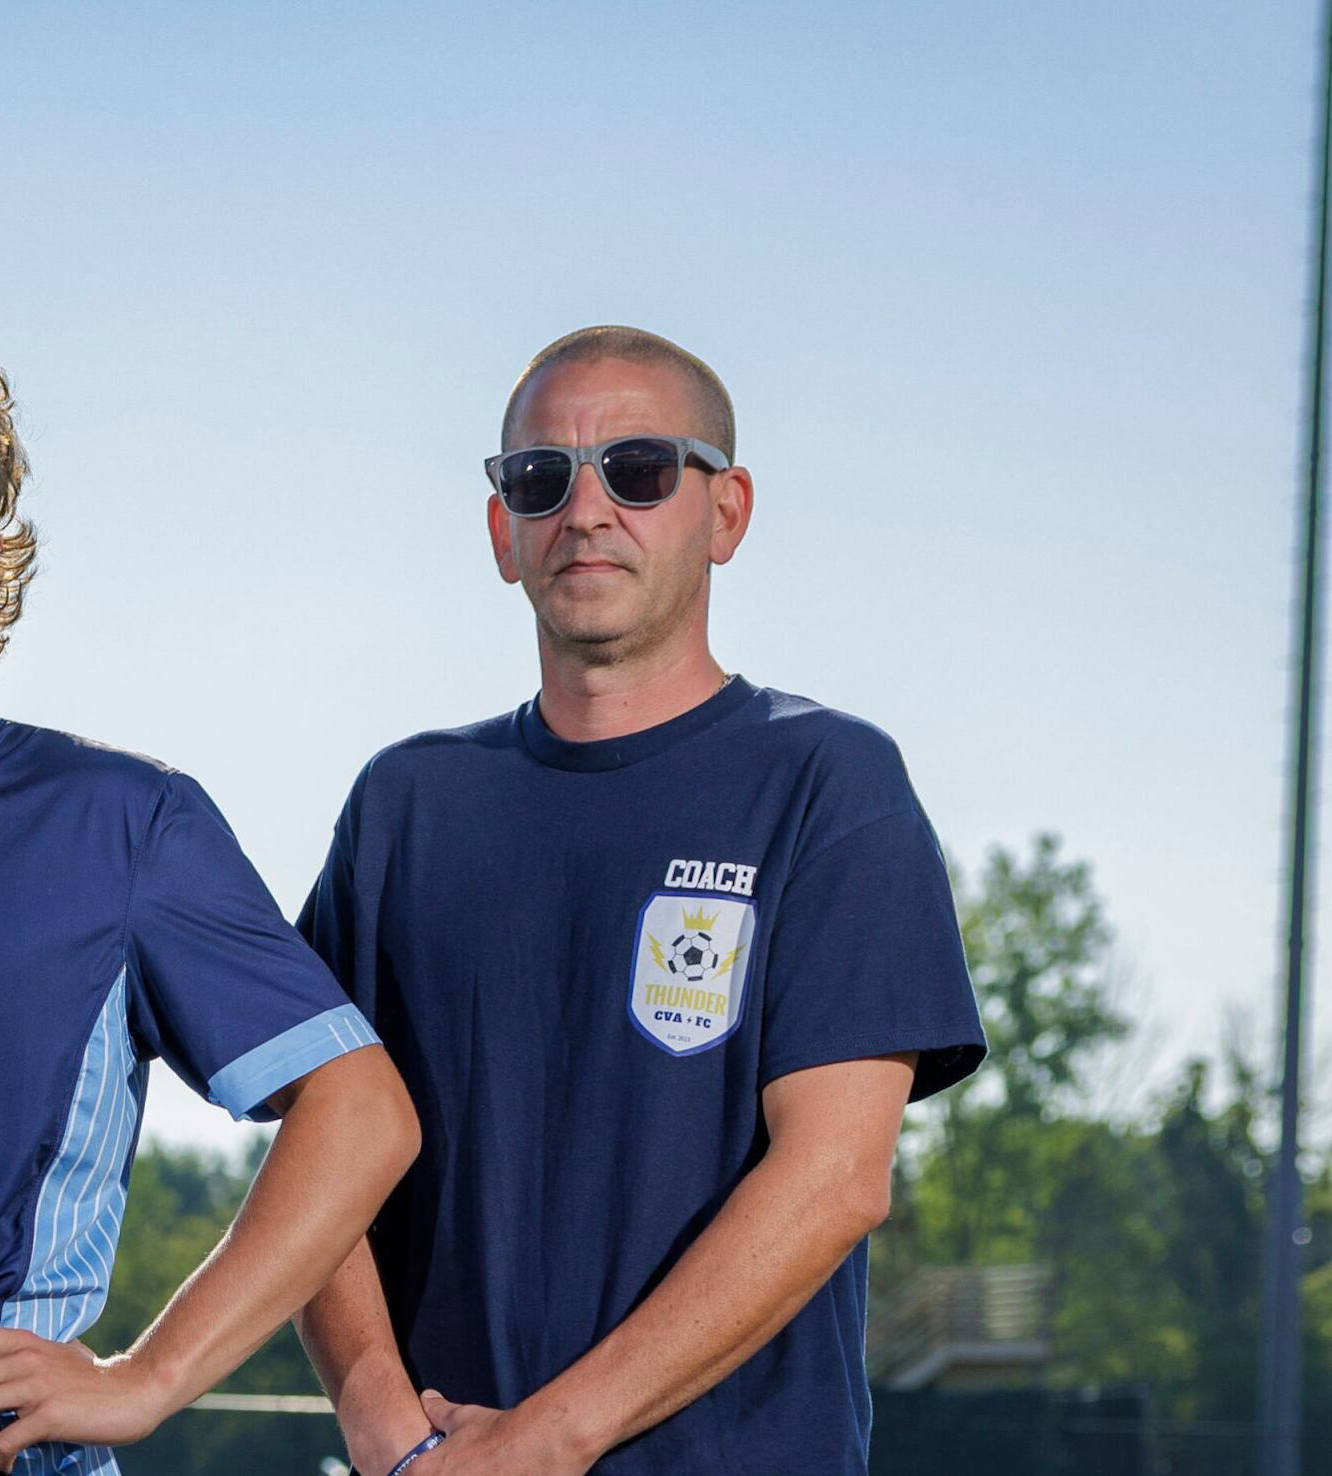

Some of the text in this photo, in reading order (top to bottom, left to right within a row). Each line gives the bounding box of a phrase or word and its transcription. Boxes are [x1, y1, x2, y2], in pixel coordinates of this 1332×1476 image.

[664, 858, 758, 896] COACH
[645, 984, 728, 1016] THUNDER
[654, 1010, 712, 1029] CVA FC
